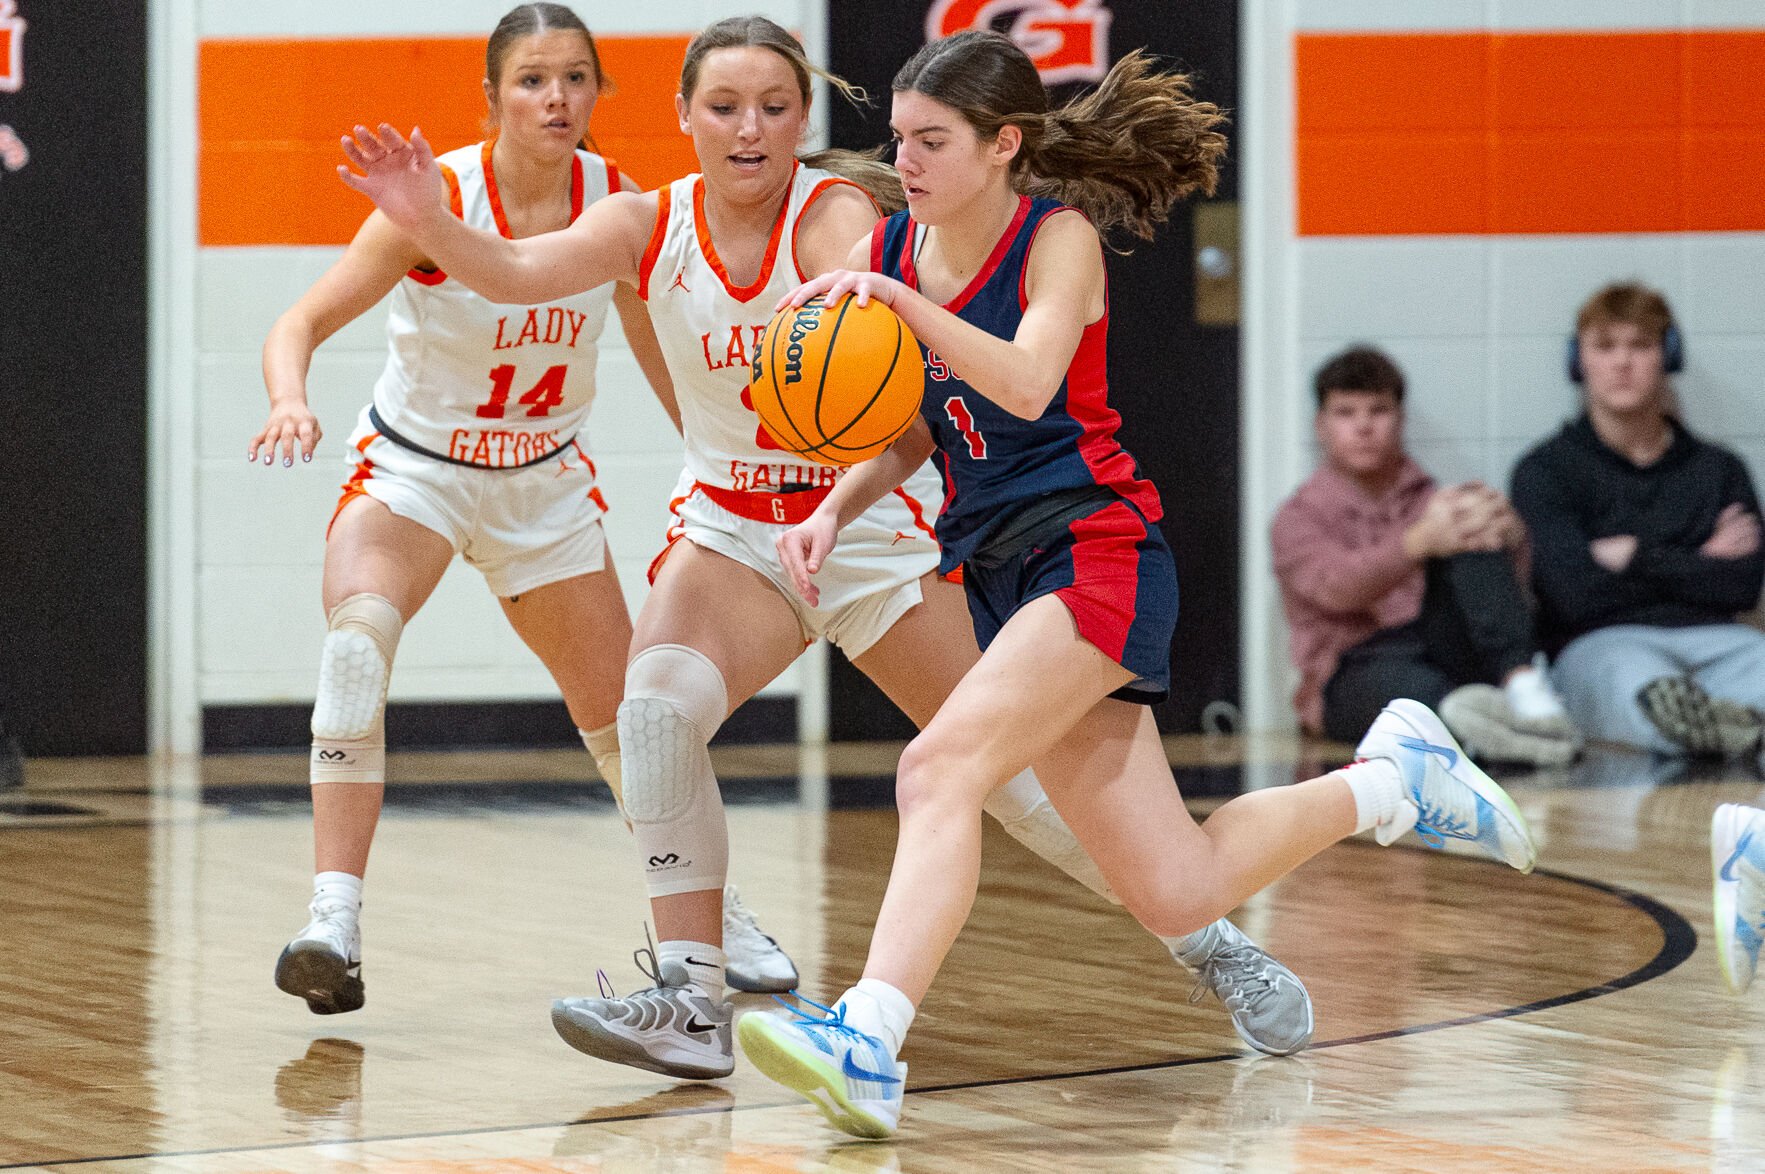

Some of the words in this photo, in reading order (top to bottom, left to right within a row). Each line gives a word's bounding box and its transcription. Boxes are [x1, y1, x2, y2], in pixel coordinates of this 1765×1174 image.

[493, 307, 587, 350] LADY
[476, 363, 568, 419] 14
[943, 396, 988, 460] 1
[771, 498, 785, 522] G
